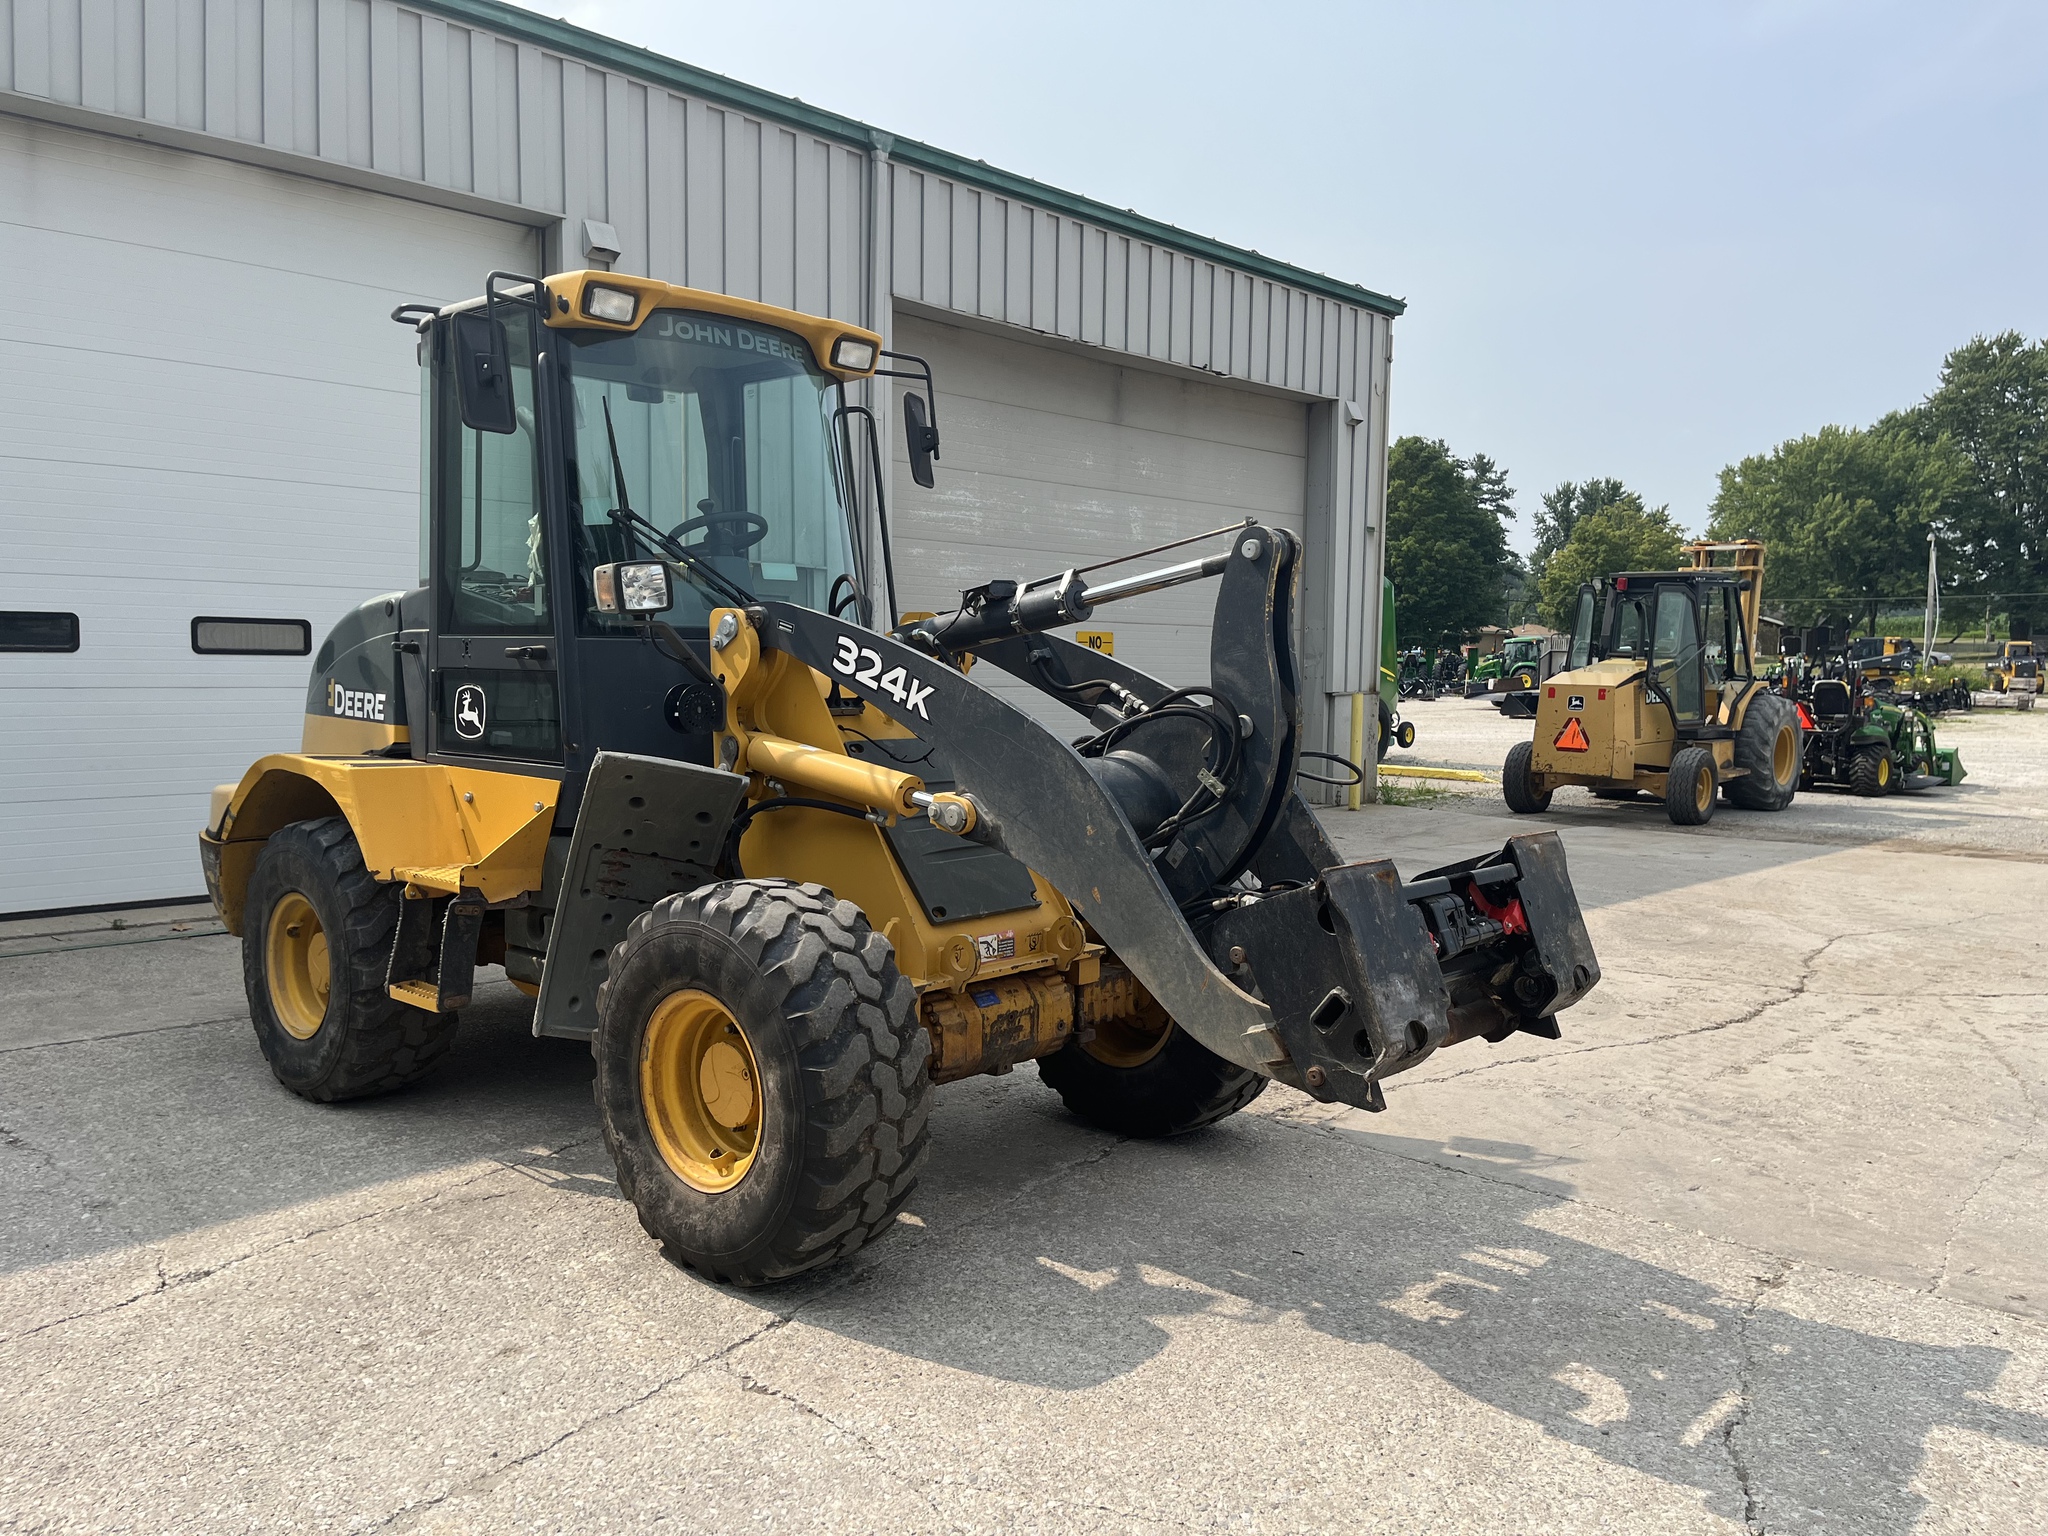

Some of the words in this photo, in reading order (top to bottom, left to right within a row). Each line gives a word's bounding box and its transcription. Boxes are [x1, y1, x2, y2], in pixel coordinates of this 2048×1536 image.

[659, 316, 731, 347] JOHN
[736, 328, 805, 363] DEERE
[1088, 635, 1102, 649] NO
[832, 635, 935, 721] 324K
[334, 683, 386, 720] DEERE
